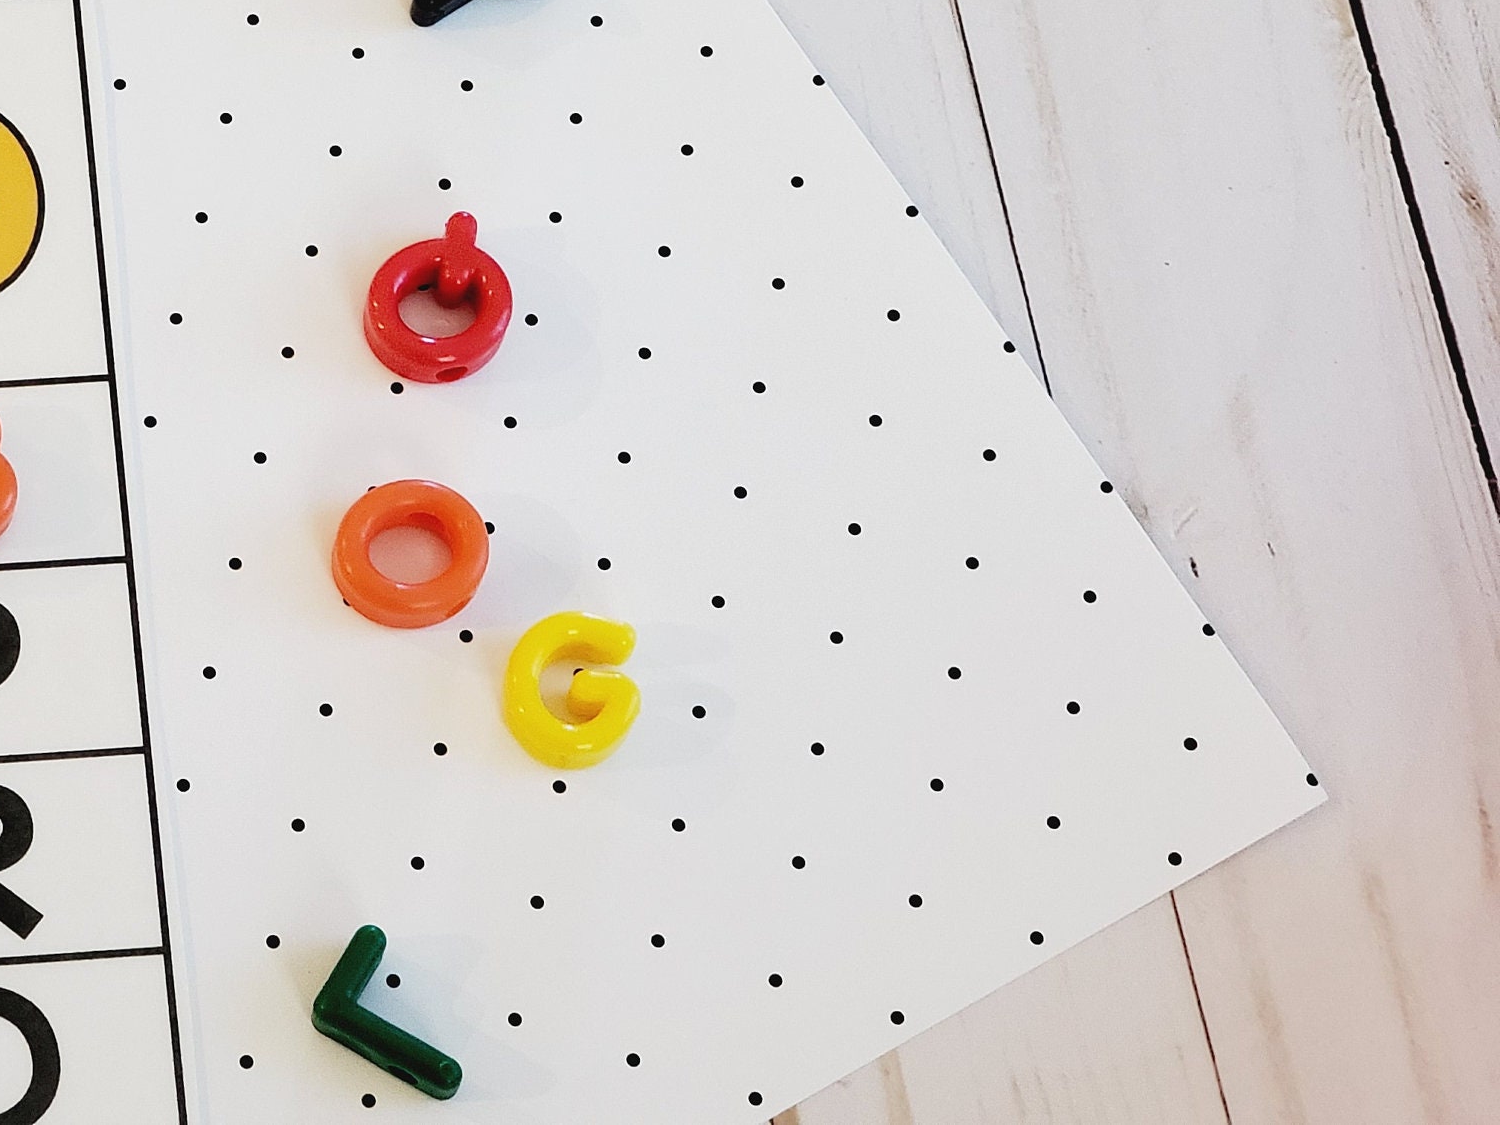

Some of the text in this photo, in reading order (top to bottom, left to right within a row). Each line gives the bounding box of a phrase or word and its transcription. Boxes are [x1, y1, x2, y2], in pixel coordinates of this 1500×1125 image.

[363, 211, 513, 381] Q
[332, 478, 490, 629] O
[504, 610, 641, 770] G
